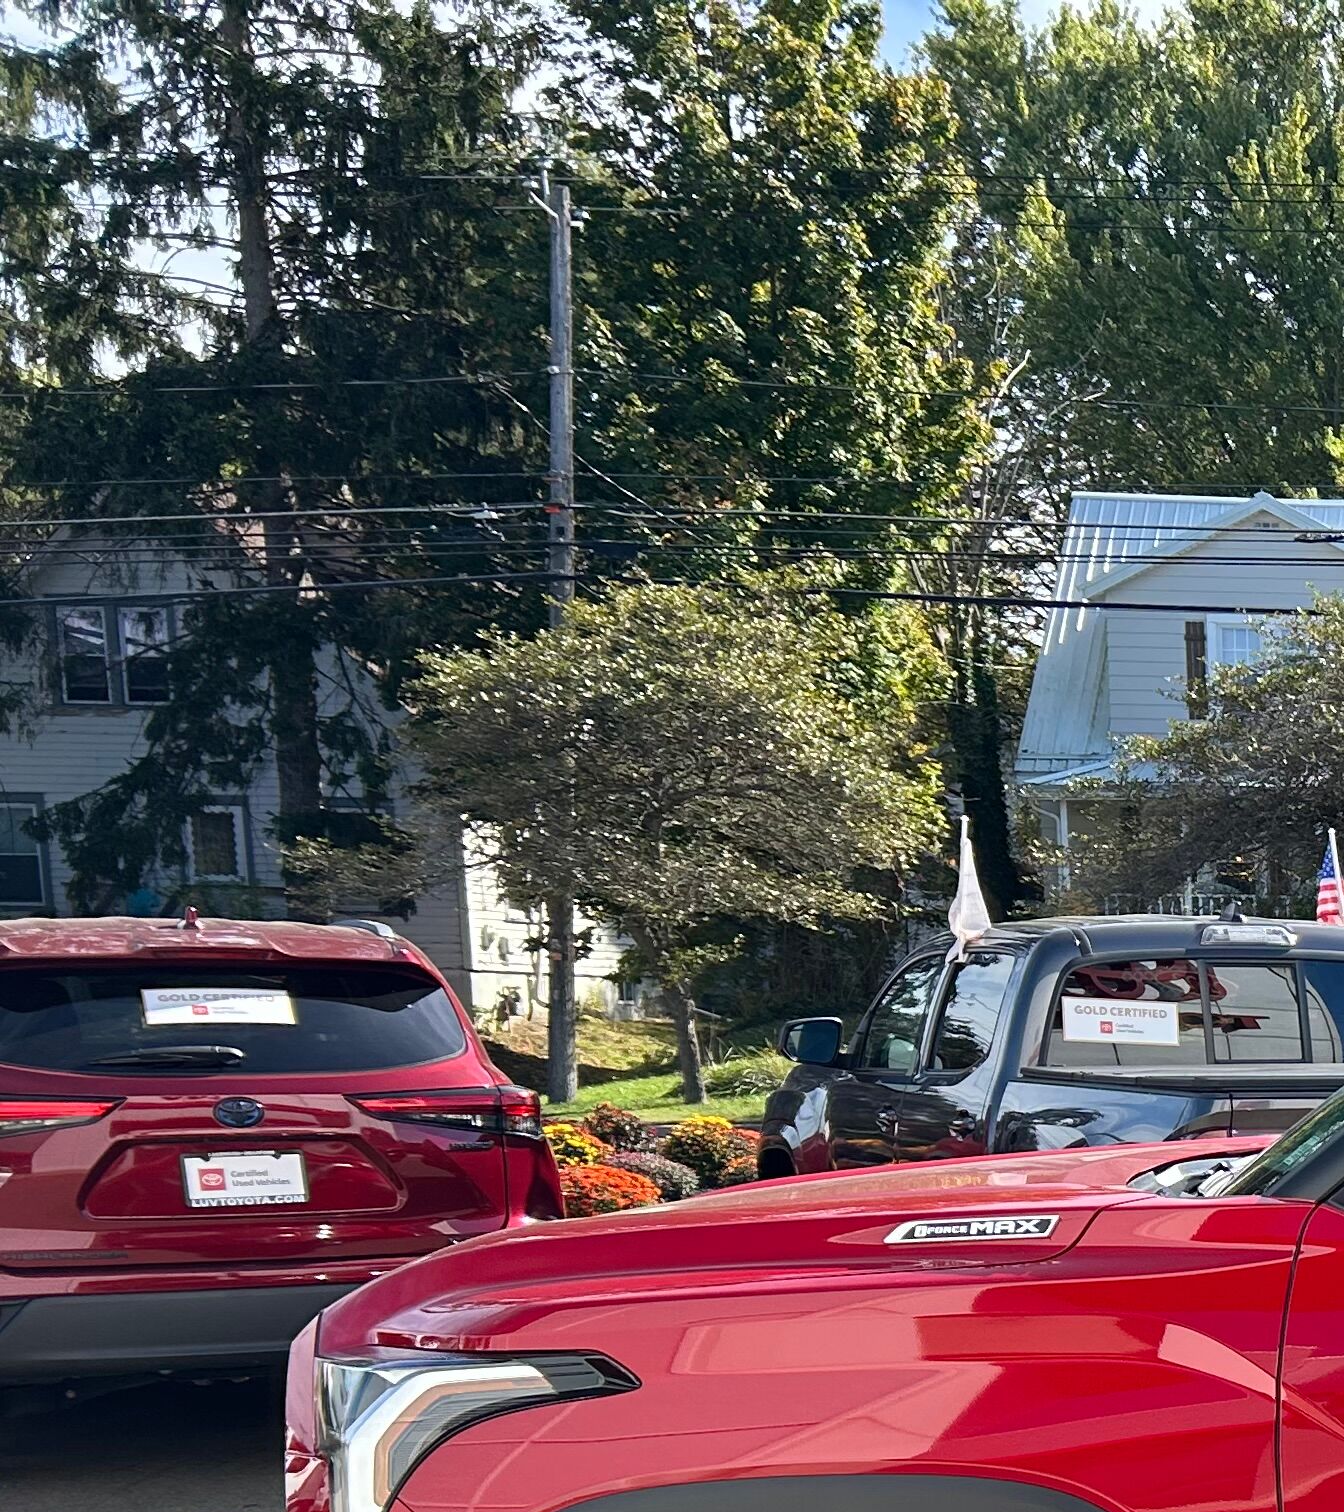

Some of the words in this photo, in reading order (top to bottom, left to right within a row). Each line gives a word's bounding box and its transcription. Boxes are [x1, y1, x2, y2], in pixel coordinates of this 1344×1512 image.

[157, 993, 200, 1002] GOLD
[1074, 1005, 1108, 1015] GOLD
[1110, 1007, 1168, 1018] CERTIFIED
[230, 1169, 268, 1177] Certified
[191, 1194, 305, 1207] LUVTOYOTA.COM
[969, 1219, 1041, 1234] MAX
